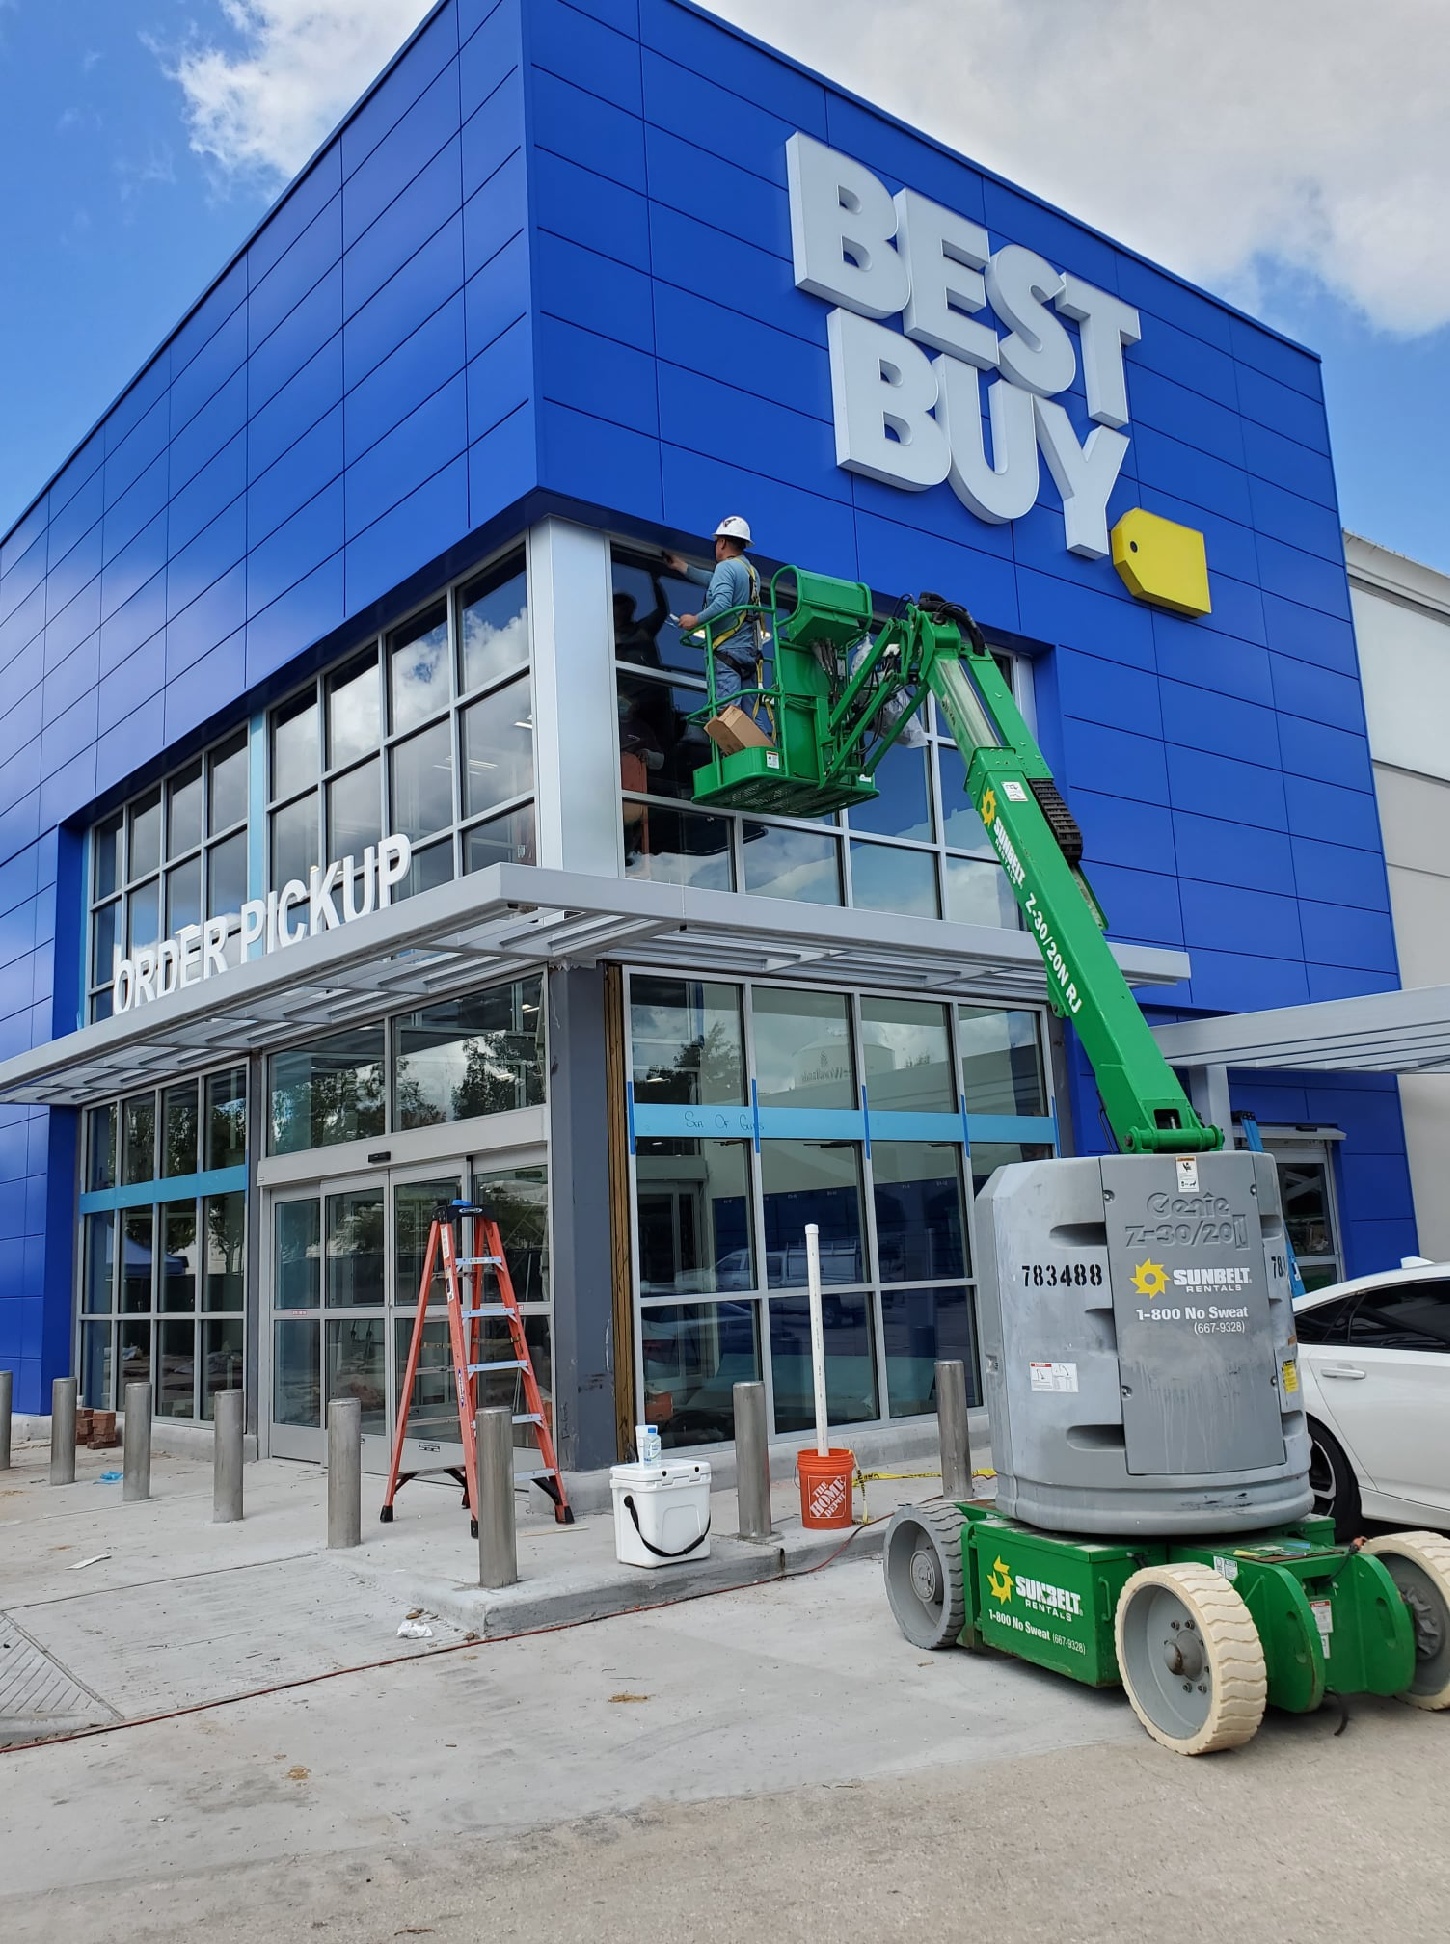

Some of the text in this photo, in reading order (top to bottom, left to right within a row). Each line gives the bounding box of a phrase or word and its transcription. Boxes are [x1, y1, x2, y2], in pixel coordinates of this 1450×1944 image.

[786, 131, 1141, 429] BEST
[826, 308, 1131, 560] BUY
[994, 816, 1026, 887] SUNBELT
[113, 833, 412, 1015] ORDER PICKUP
[1025, 892, 1082, 1014] Z-30/20N RJ
[1147, 1191, 1231, 1219] Genie
[1021, 1263, 1103, 1287] 783488
[1173, 1267, 1251, 1286] SUNBELT
[1186, 1284, 1242, 1293] RENTALS
[1136, 1306, 1249, 1321] 1-800 No Sweat
[1194, 1321, 1246, 1336] (667-9328)
[810, 1476, 845, 1518] HOME
[812, 1480, 829, 1498] THE
[824, 1490, 846, 1518] DEPOT
[1015, 1575, 1082, 1615] SUNBELT
[988, 1608, 1012, 1627] 1-800
[1012, 1616, 1024, 1632] No
[1024, 1620, 1051, 1641] Sweat
[1025, 1599, 1073, 1622] RENTALS
